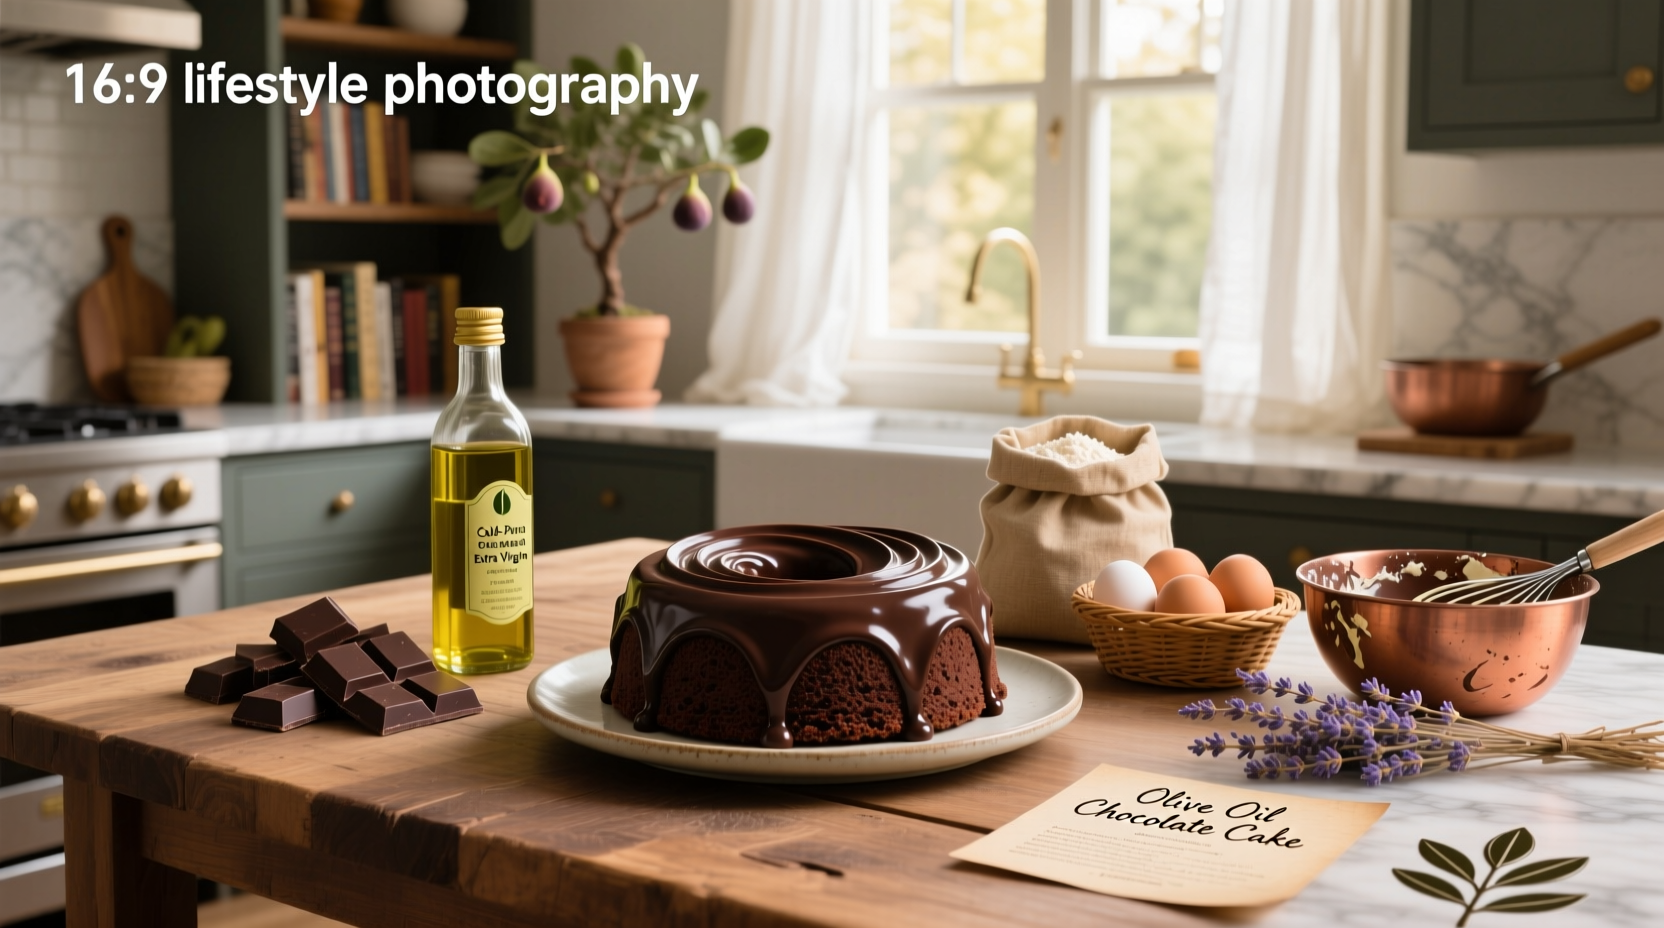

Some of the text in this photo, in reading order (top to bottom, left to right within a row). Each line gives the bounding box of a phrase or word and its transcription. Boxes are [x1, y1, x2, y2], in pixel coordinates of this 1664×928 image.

[500, 551, 528, 564] Virgin
[1136, 787, 1287, 822] Olive Oil
[1074, 798, 1215, 835] Chocolate
[1225, 823, 1304, 849] Cake
